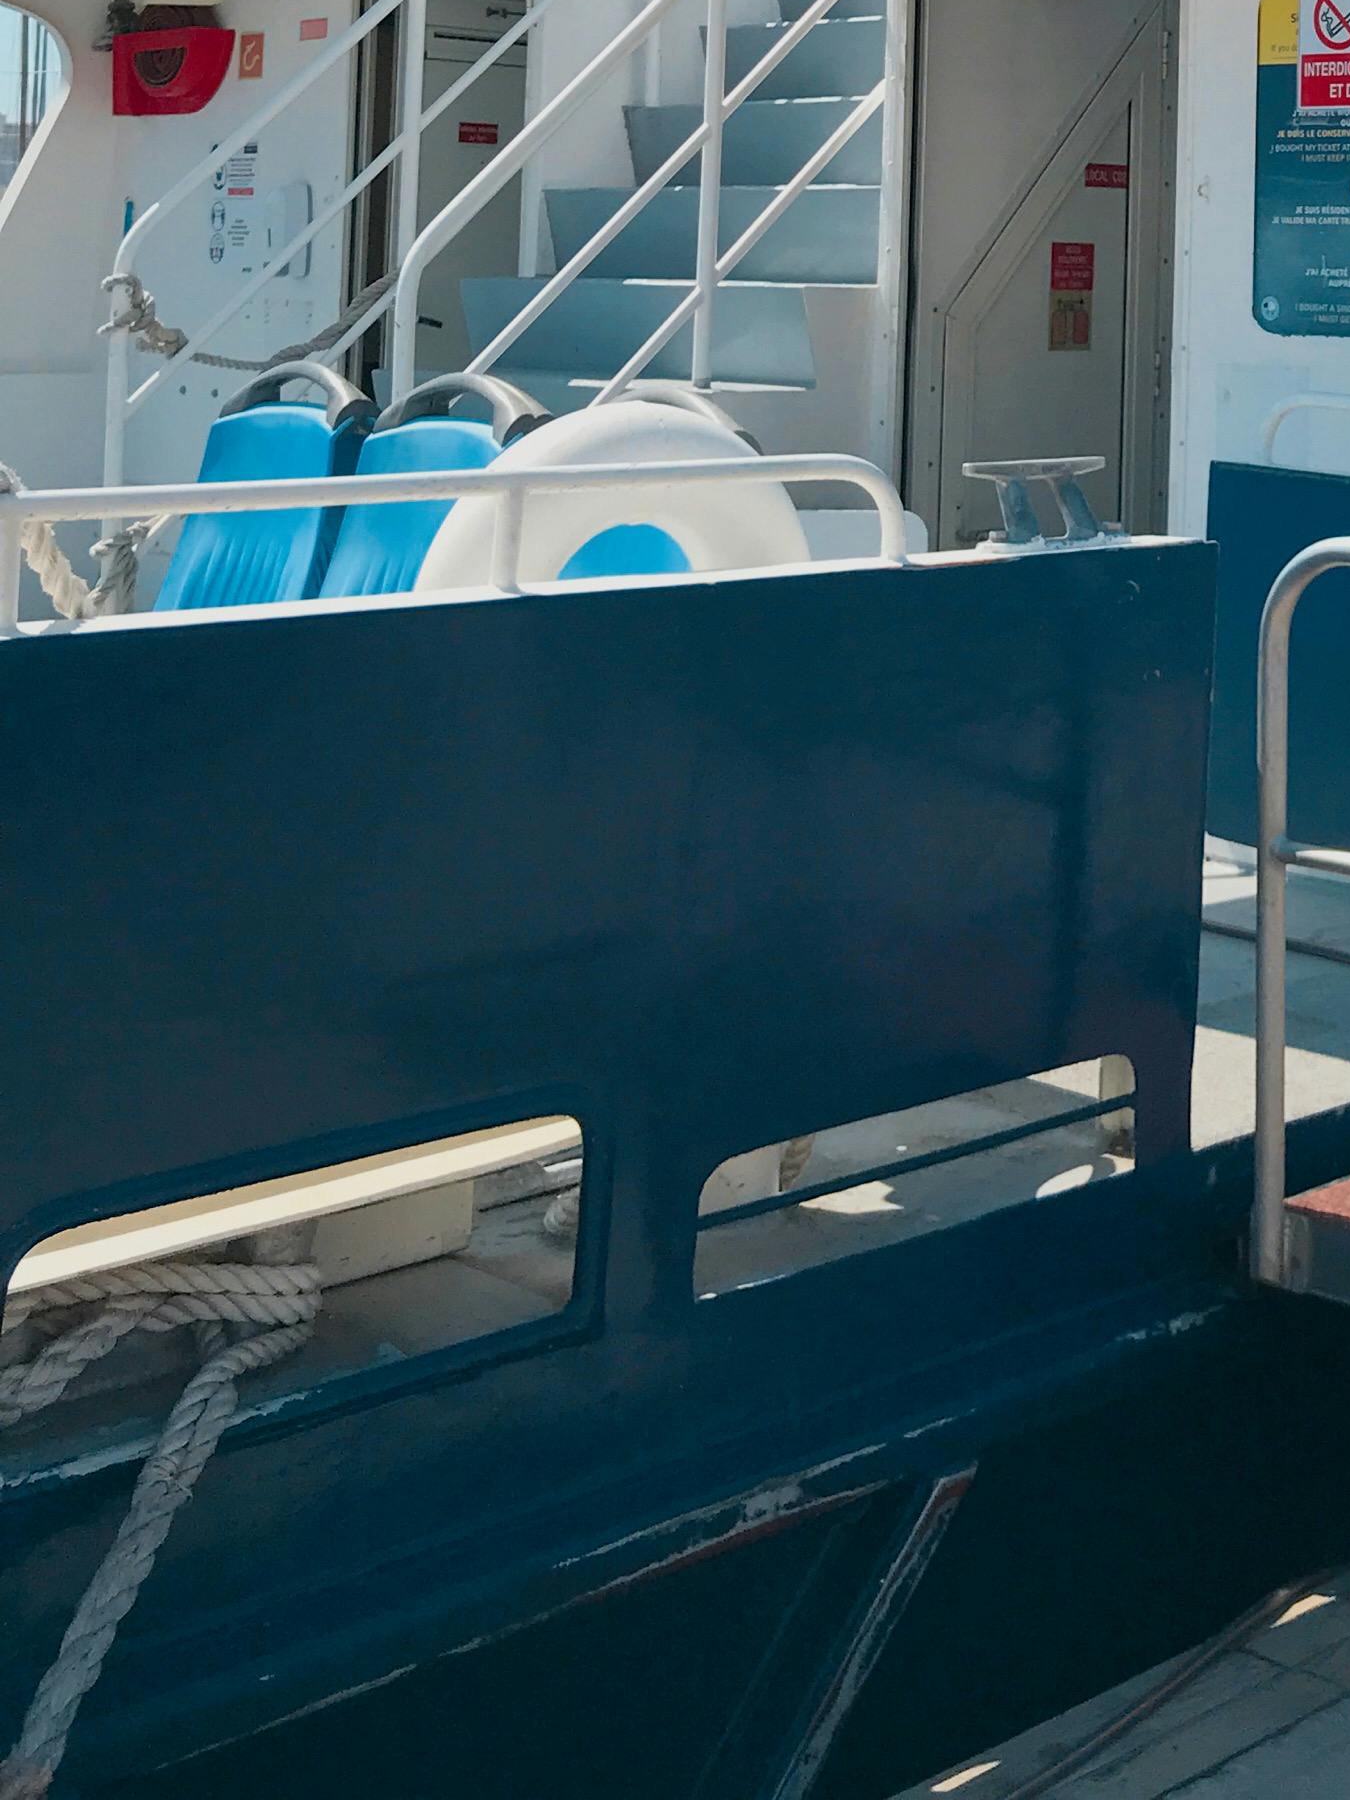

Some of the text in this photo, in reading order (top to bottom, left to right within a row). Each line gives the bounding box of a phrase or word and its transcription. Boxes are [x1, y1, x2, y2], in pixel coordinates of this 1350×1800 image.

[1329, 83, 1344, 99] ET
[1277, 130, 1285, 138] JE
[1287, 129, 1305, 138] DOIS
[1306, 129, 1315, 138] LE
[1275, 143, 1303, 153] BOUGHT
[1304, 143, 1317, 152] MY
[1317, 143, 1341, 152] TICKET
[1318, 217, 1340, 225] CARTE
